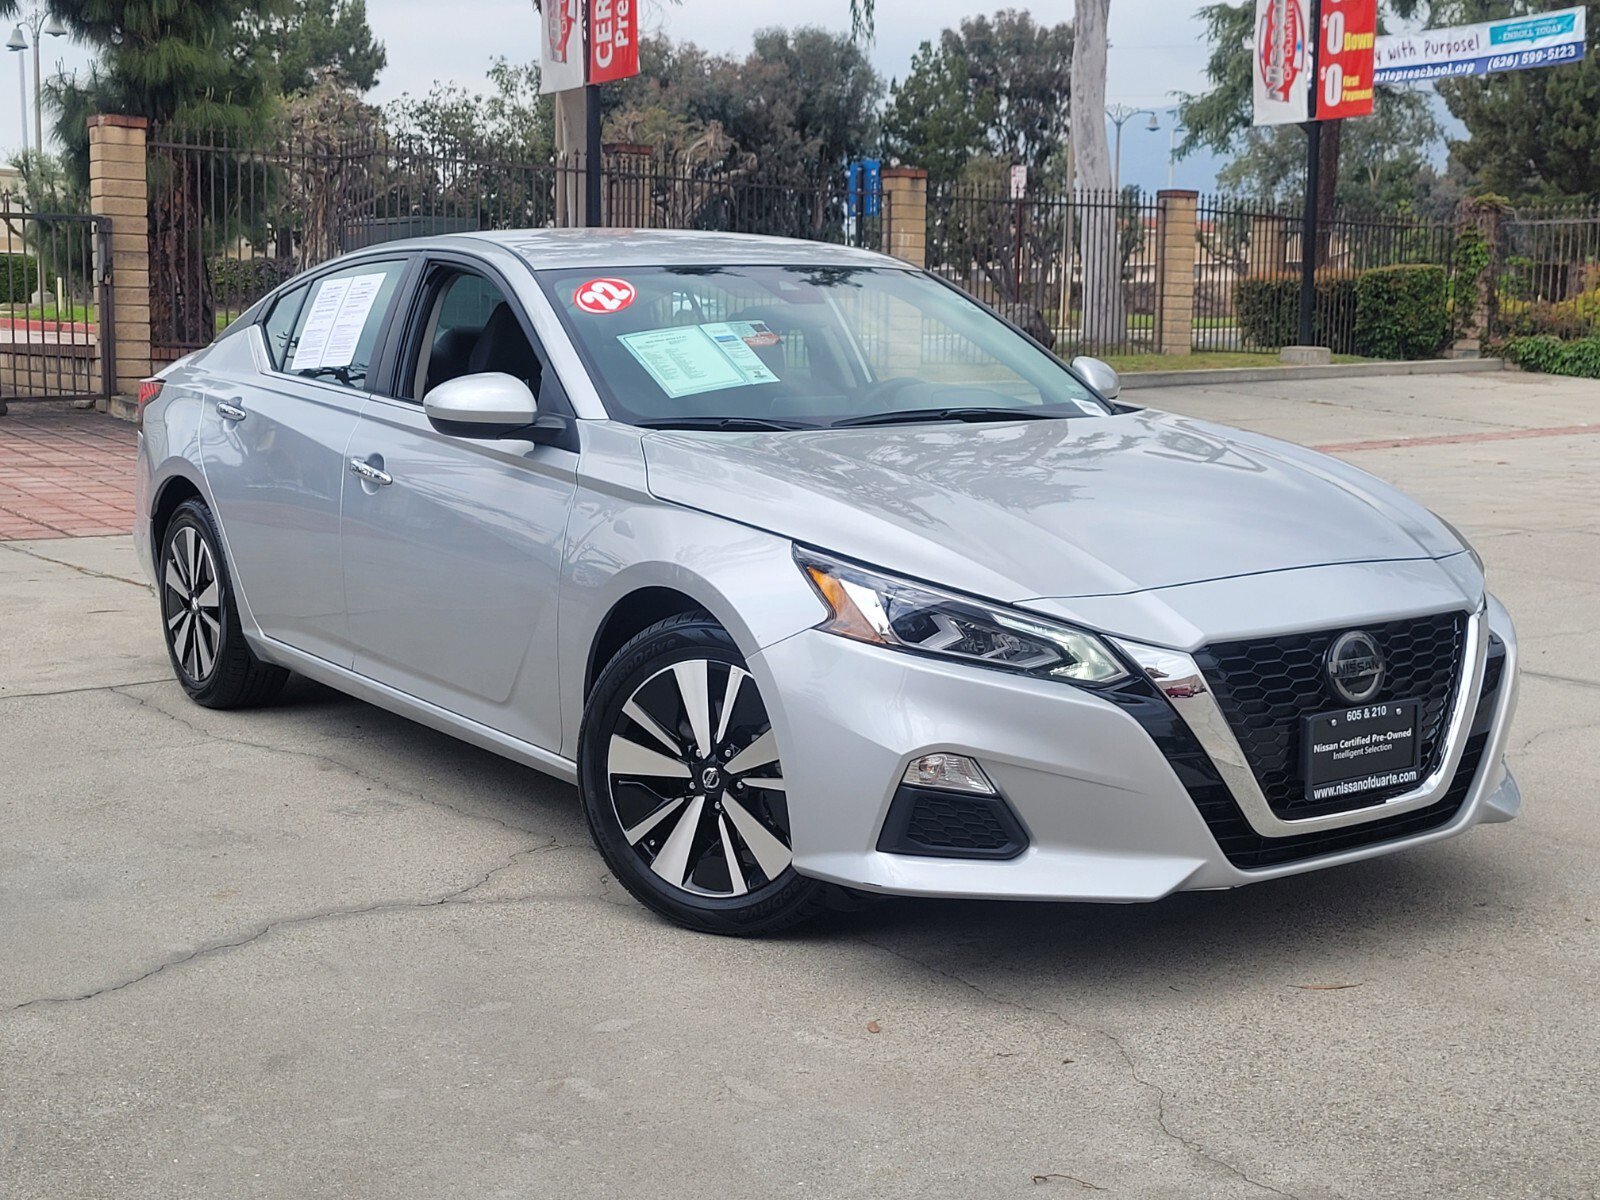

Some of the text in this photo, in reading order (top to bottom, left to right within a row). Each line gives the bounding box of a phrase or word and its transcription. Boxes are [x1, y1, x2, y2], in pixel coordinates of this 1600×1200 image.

[1284, 1, 1295, 81] OF DUARTE
[1343, 32, 1374, 52] Down
[581, 281, 631, 310] 22
[1336, 658, 1381, 674] NISSAN
[1346, 705, 1387, 722] 605 & 210
[1313, 727, 1412, 754] Nissan Certified Pre-Owned
[1333, 743, 1393, 760] Intelligent Selection
[1313, 771, 1417, 800] www.nissanofduarte.com
